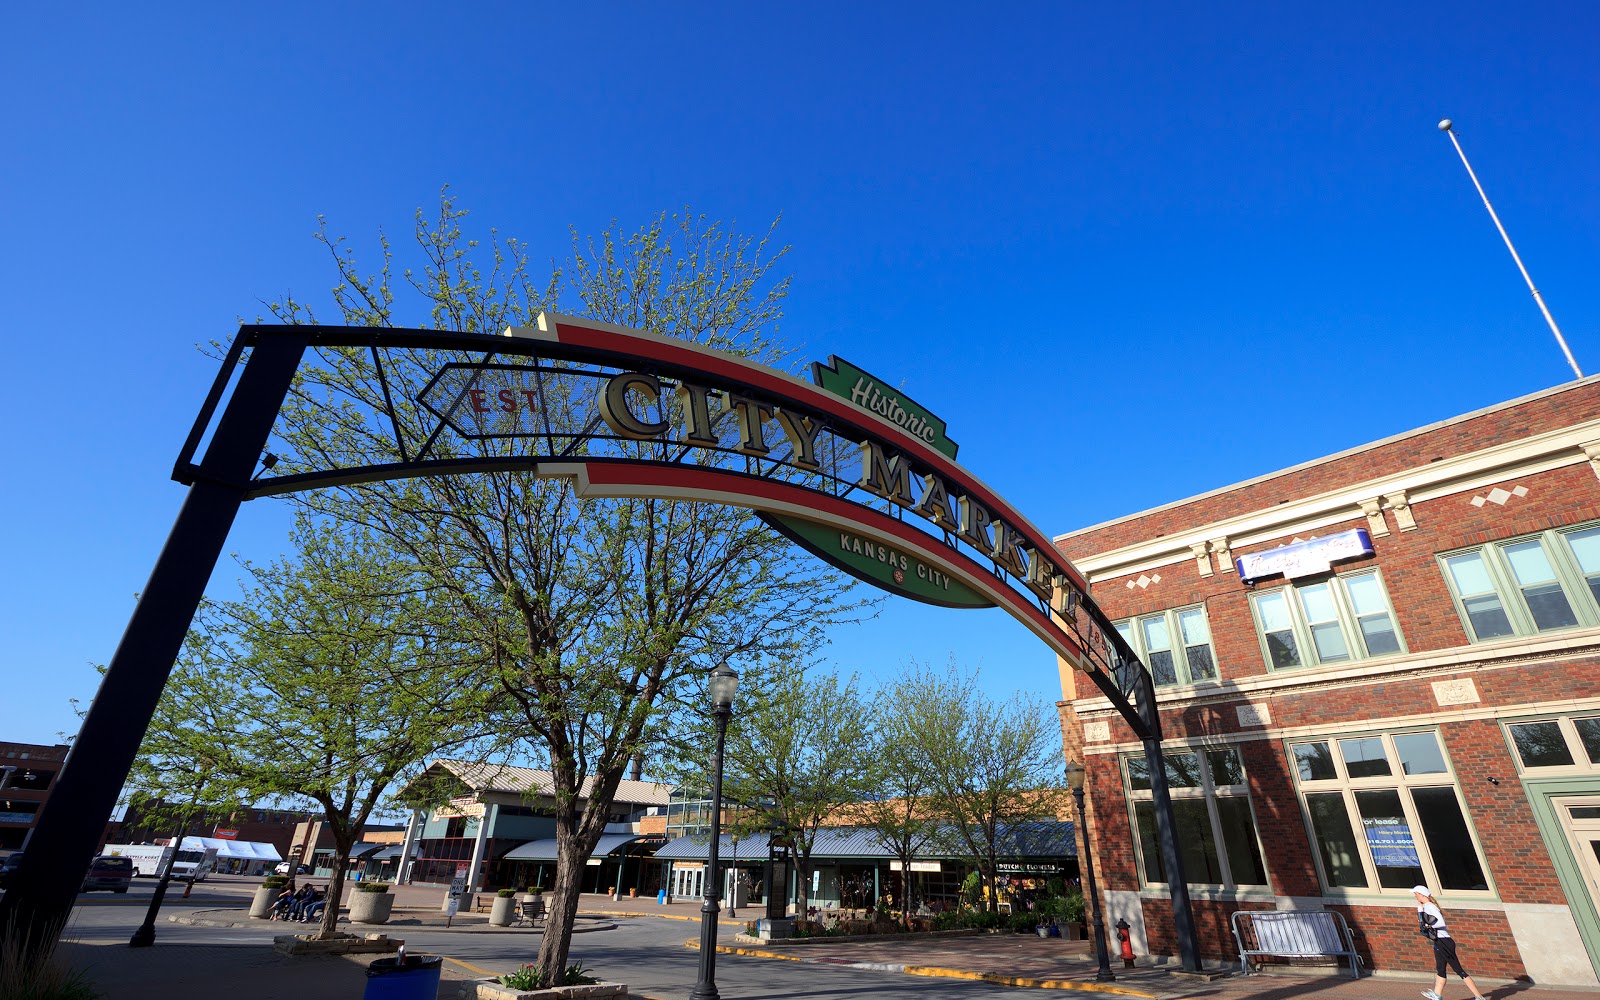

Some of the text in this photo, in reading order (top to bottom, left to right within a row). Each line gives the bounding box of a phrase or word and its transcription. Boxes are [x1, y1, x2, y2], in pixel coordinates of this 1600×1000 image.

[851, 377, 936, 445] Historic
[598, 372, 1083, 624] CITY MARKET
[839, 533, 951, 591] KANSAS CITY
[1089, 626, 1112, 657] 1857
